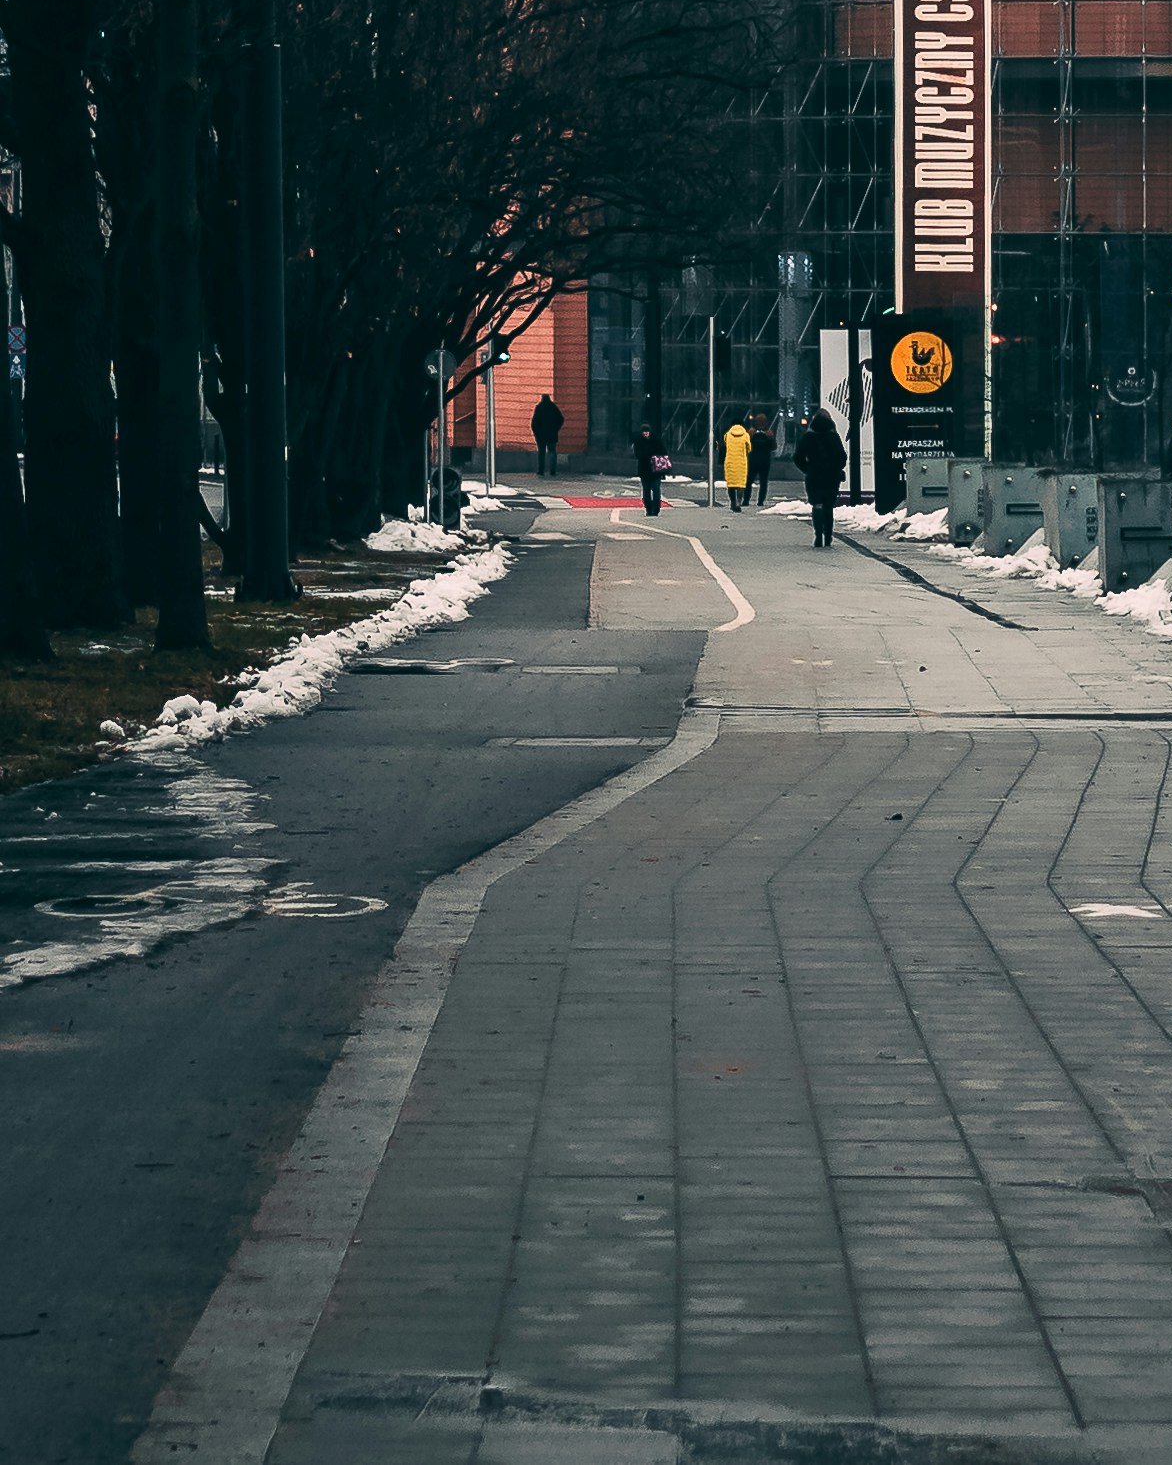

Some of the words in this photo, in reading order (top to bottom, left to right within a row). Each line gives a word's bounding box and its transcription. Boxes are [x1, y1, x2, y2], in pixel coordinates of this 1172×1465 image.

[914, 31, 974, 189] MUZYCZNY
[914, 198, 974, 273] KLUB
[891, 451, 903, 459] NA
[897, 439, 948, 448] ZAPRASZAM
